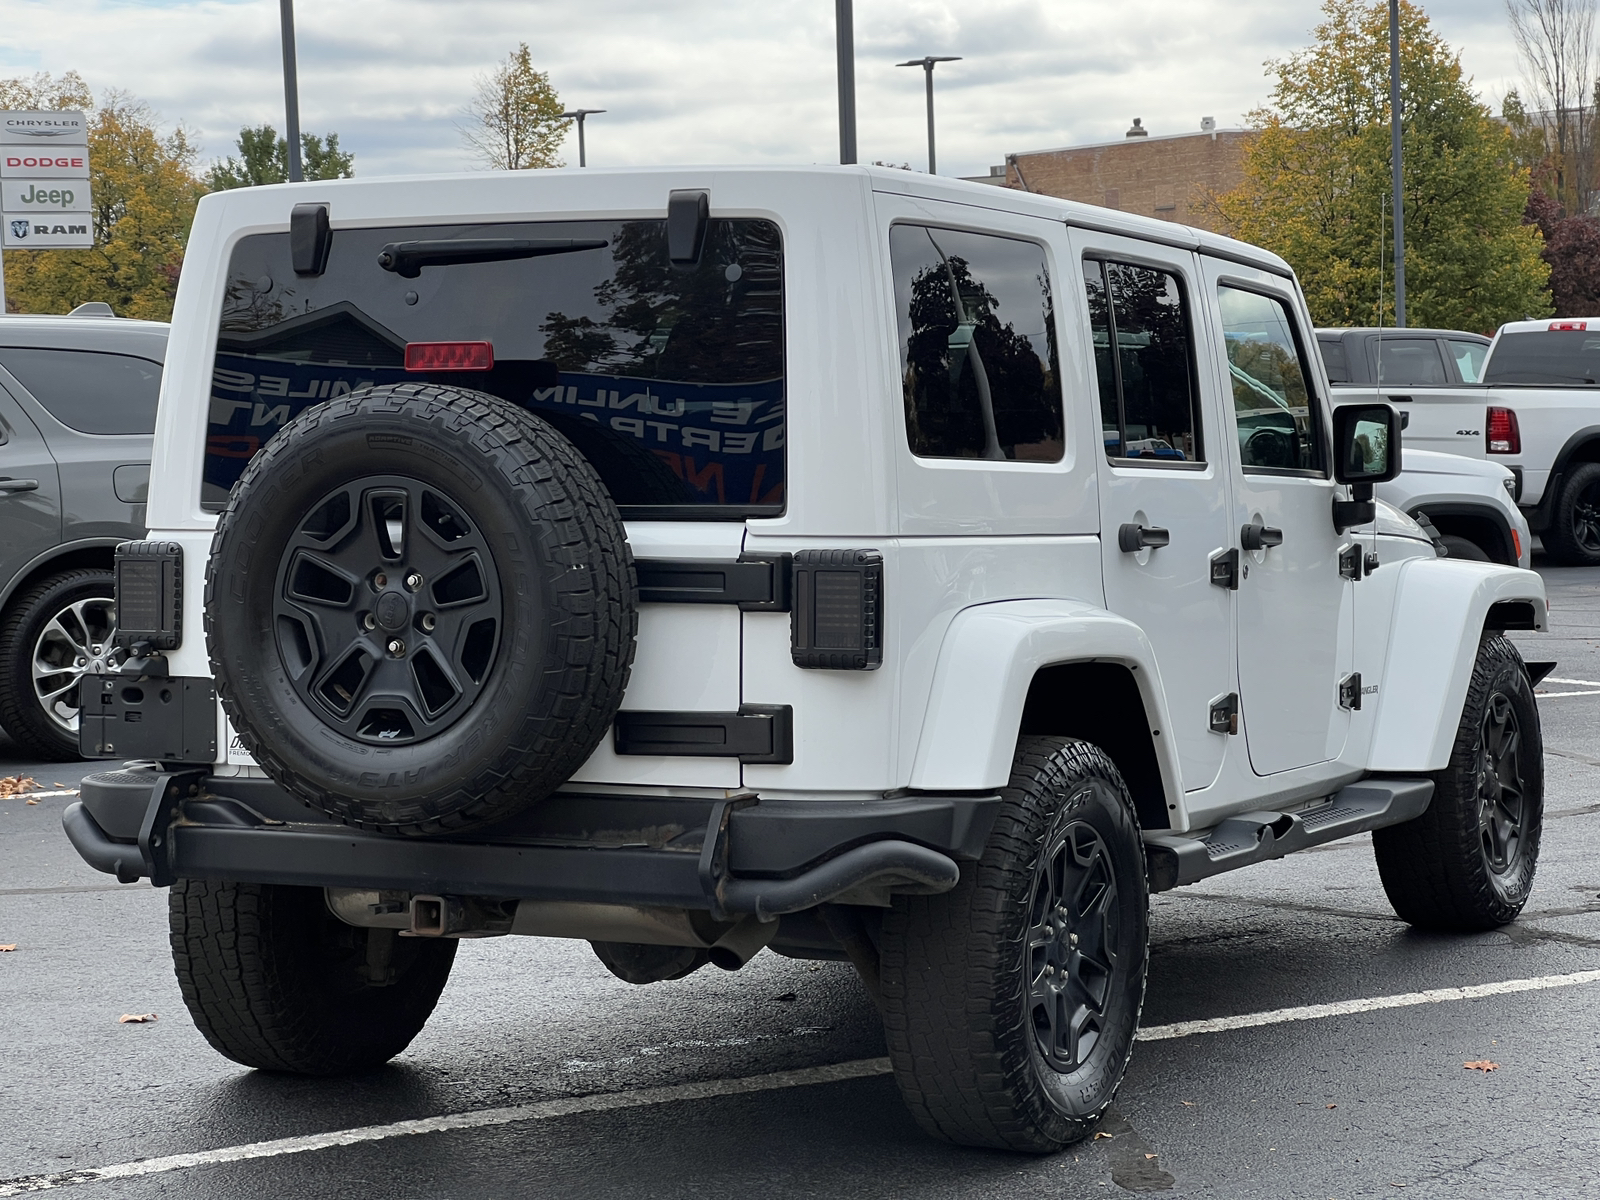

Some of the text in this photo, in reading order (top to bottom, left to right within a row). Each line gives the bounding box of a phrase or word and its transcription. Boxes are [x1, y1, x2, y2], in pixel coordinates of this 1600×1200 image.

[7, 157, 83, 168] DODGE
[20, 184, 74, 208] Jeep
[34, 225, 87, 235] RAM
